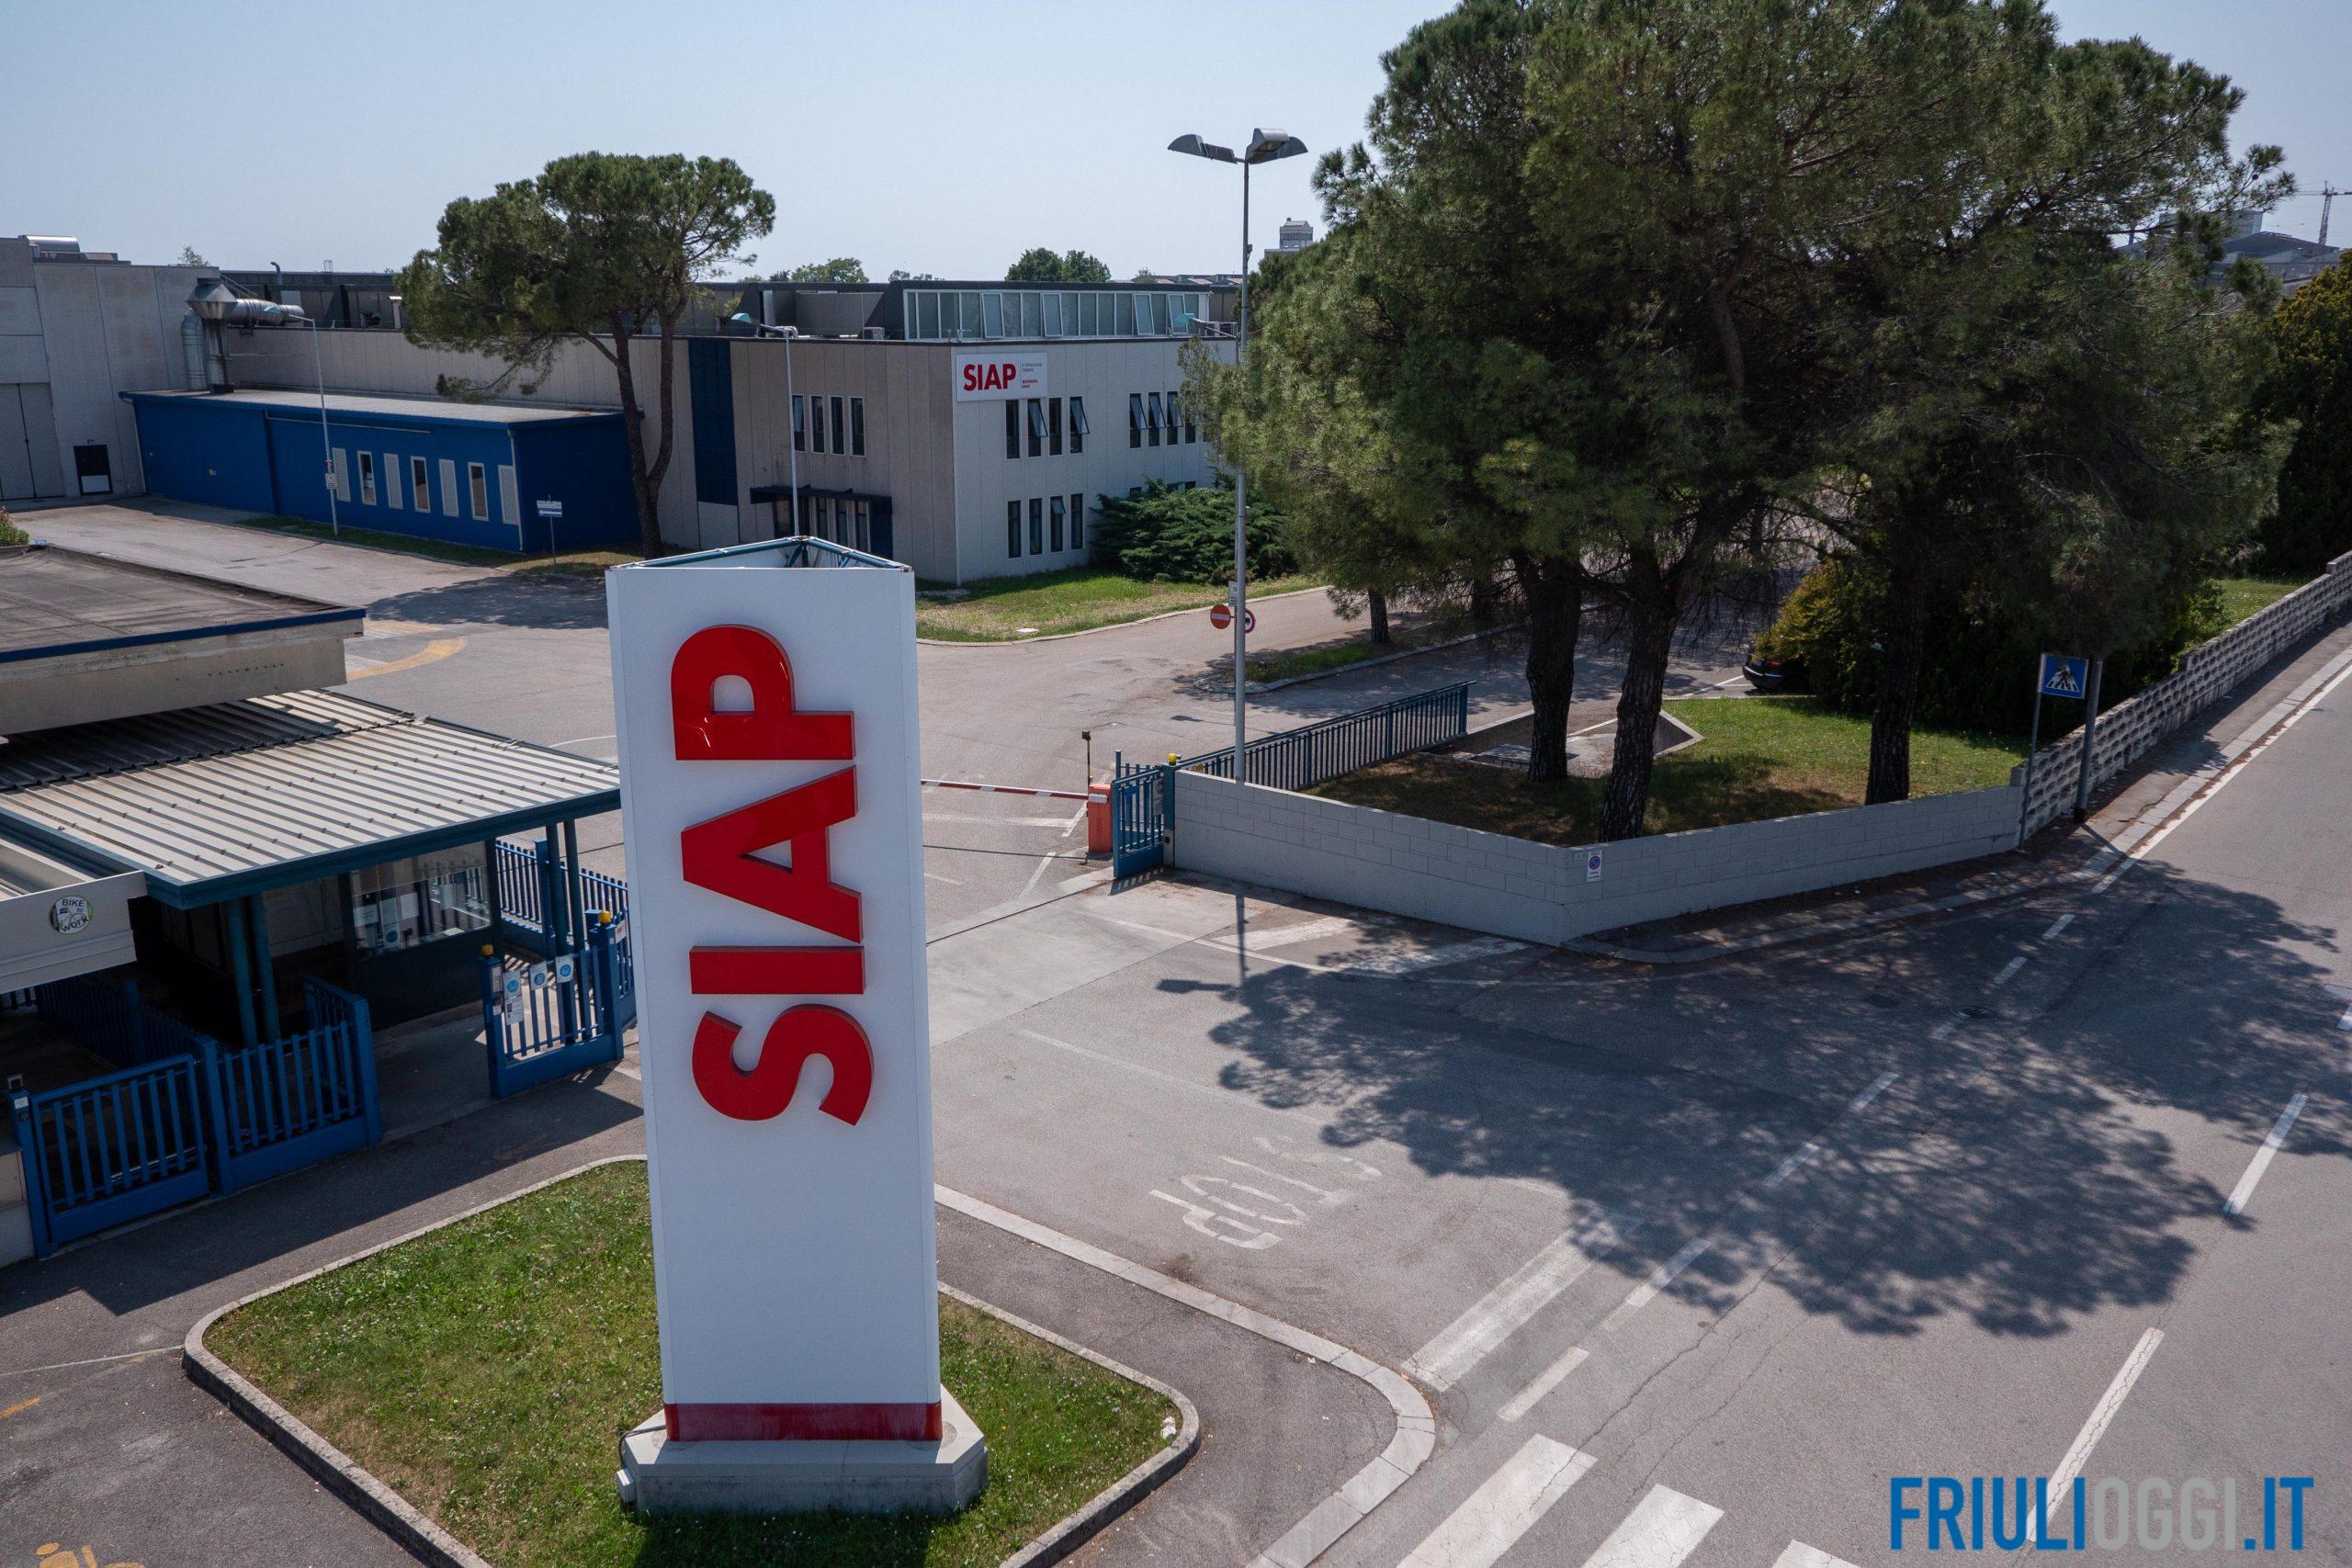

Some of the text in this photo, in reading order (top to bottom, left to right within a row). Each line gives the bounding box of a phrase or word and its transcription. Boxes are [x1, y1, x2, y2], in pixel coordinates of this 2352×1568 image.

[963, 363, 1017, 392] SIAP
[671, 624, 875, 1126] SIAP
[62, 898, 85, 907] BIKE
[61, 915, 89, 932] work
